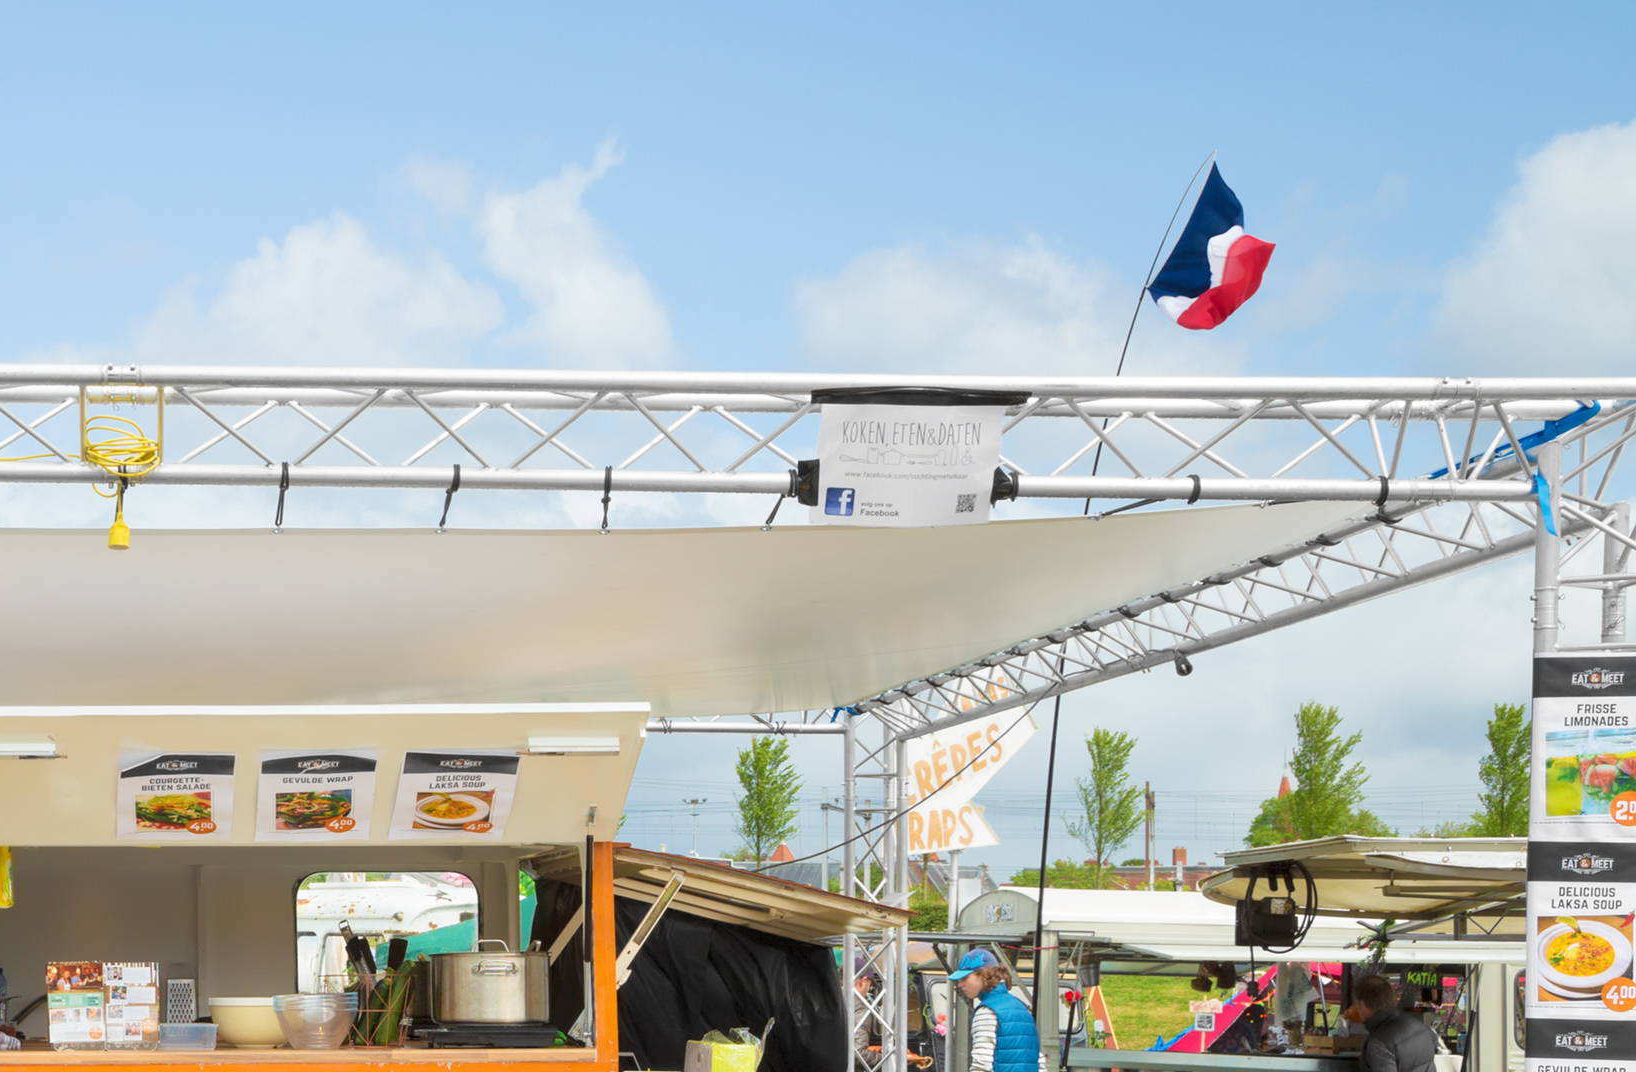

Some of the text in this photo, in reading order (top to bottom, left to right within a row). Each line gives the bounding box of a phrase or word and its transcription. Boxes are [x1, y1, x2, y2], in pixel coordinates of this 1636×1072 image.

[845, 471, 968, 481] www.facebook.com/stichtingmetelkaar
[860, 509, 900, 517] Facebook
[1571, 674, 1588, 684] EAT
[1601, 673, 1624, 683] MEET
[1576, 704, 1617, 714] FRISSE
[1564, 716, 1629, 727] LIMONADES
[429, 782, 459, 790] LAKSA
[189, 822, 214, 831] 4.00
[329, 819, 353, 829] 4.00
[895, 806, 974, 851] RAPS
[1561, 858, 1578, 869] EAT
[1591, 859, 1614, 869] MEET
[1558, 887, 1616, 898] DELICIOUS
[1551, 899, 1623, 910] LAKSA SOUP
[1407, 971, 1437, 987] KATIA
[1605, 985, 1636, 1005] 4.00
[1555, 1035, 1572, 1046] EAT
[1585, 1036, 1608, 1046] MEET
